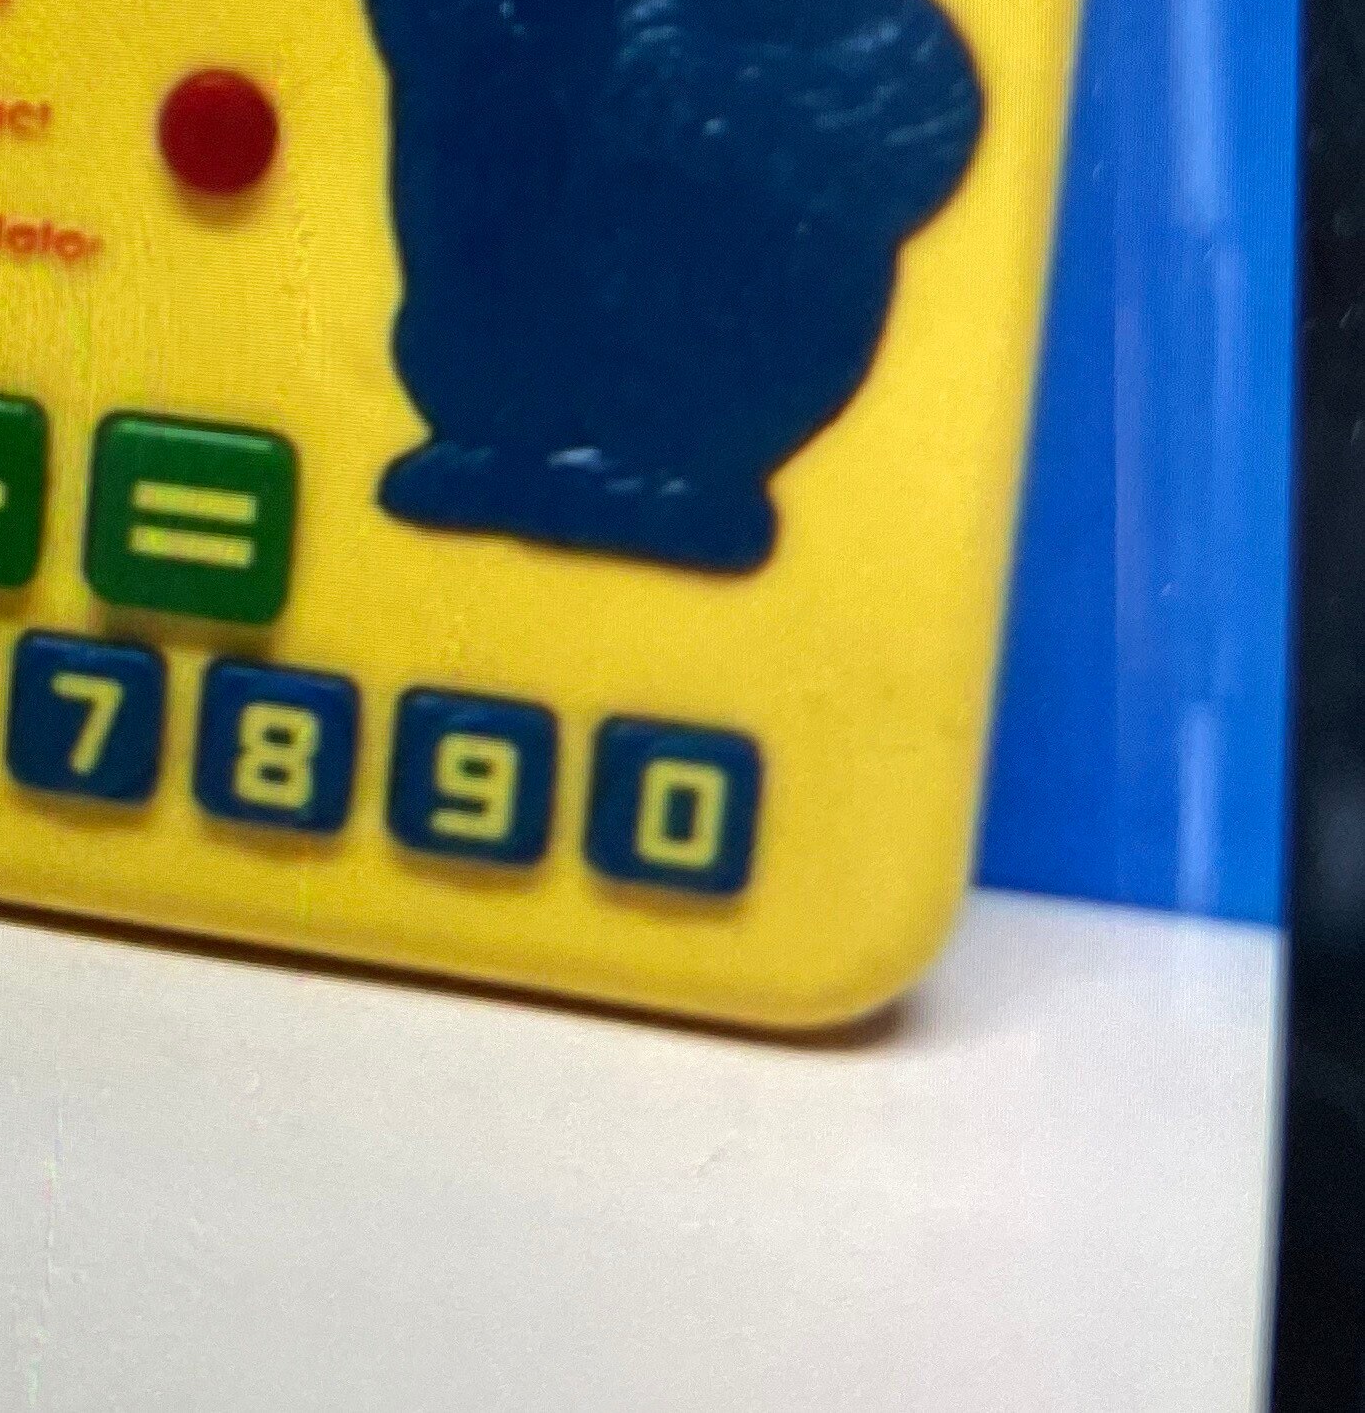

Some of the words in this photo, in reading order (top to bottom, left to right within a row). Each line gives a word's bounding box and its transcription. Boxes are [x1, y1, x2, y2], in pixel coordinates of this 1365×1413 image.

[50, 672, 124, 776] 7
[236, 701, 321, 810] 8
[430, 732, 520, 842] 9
[636, 759, 728, 870] 0
